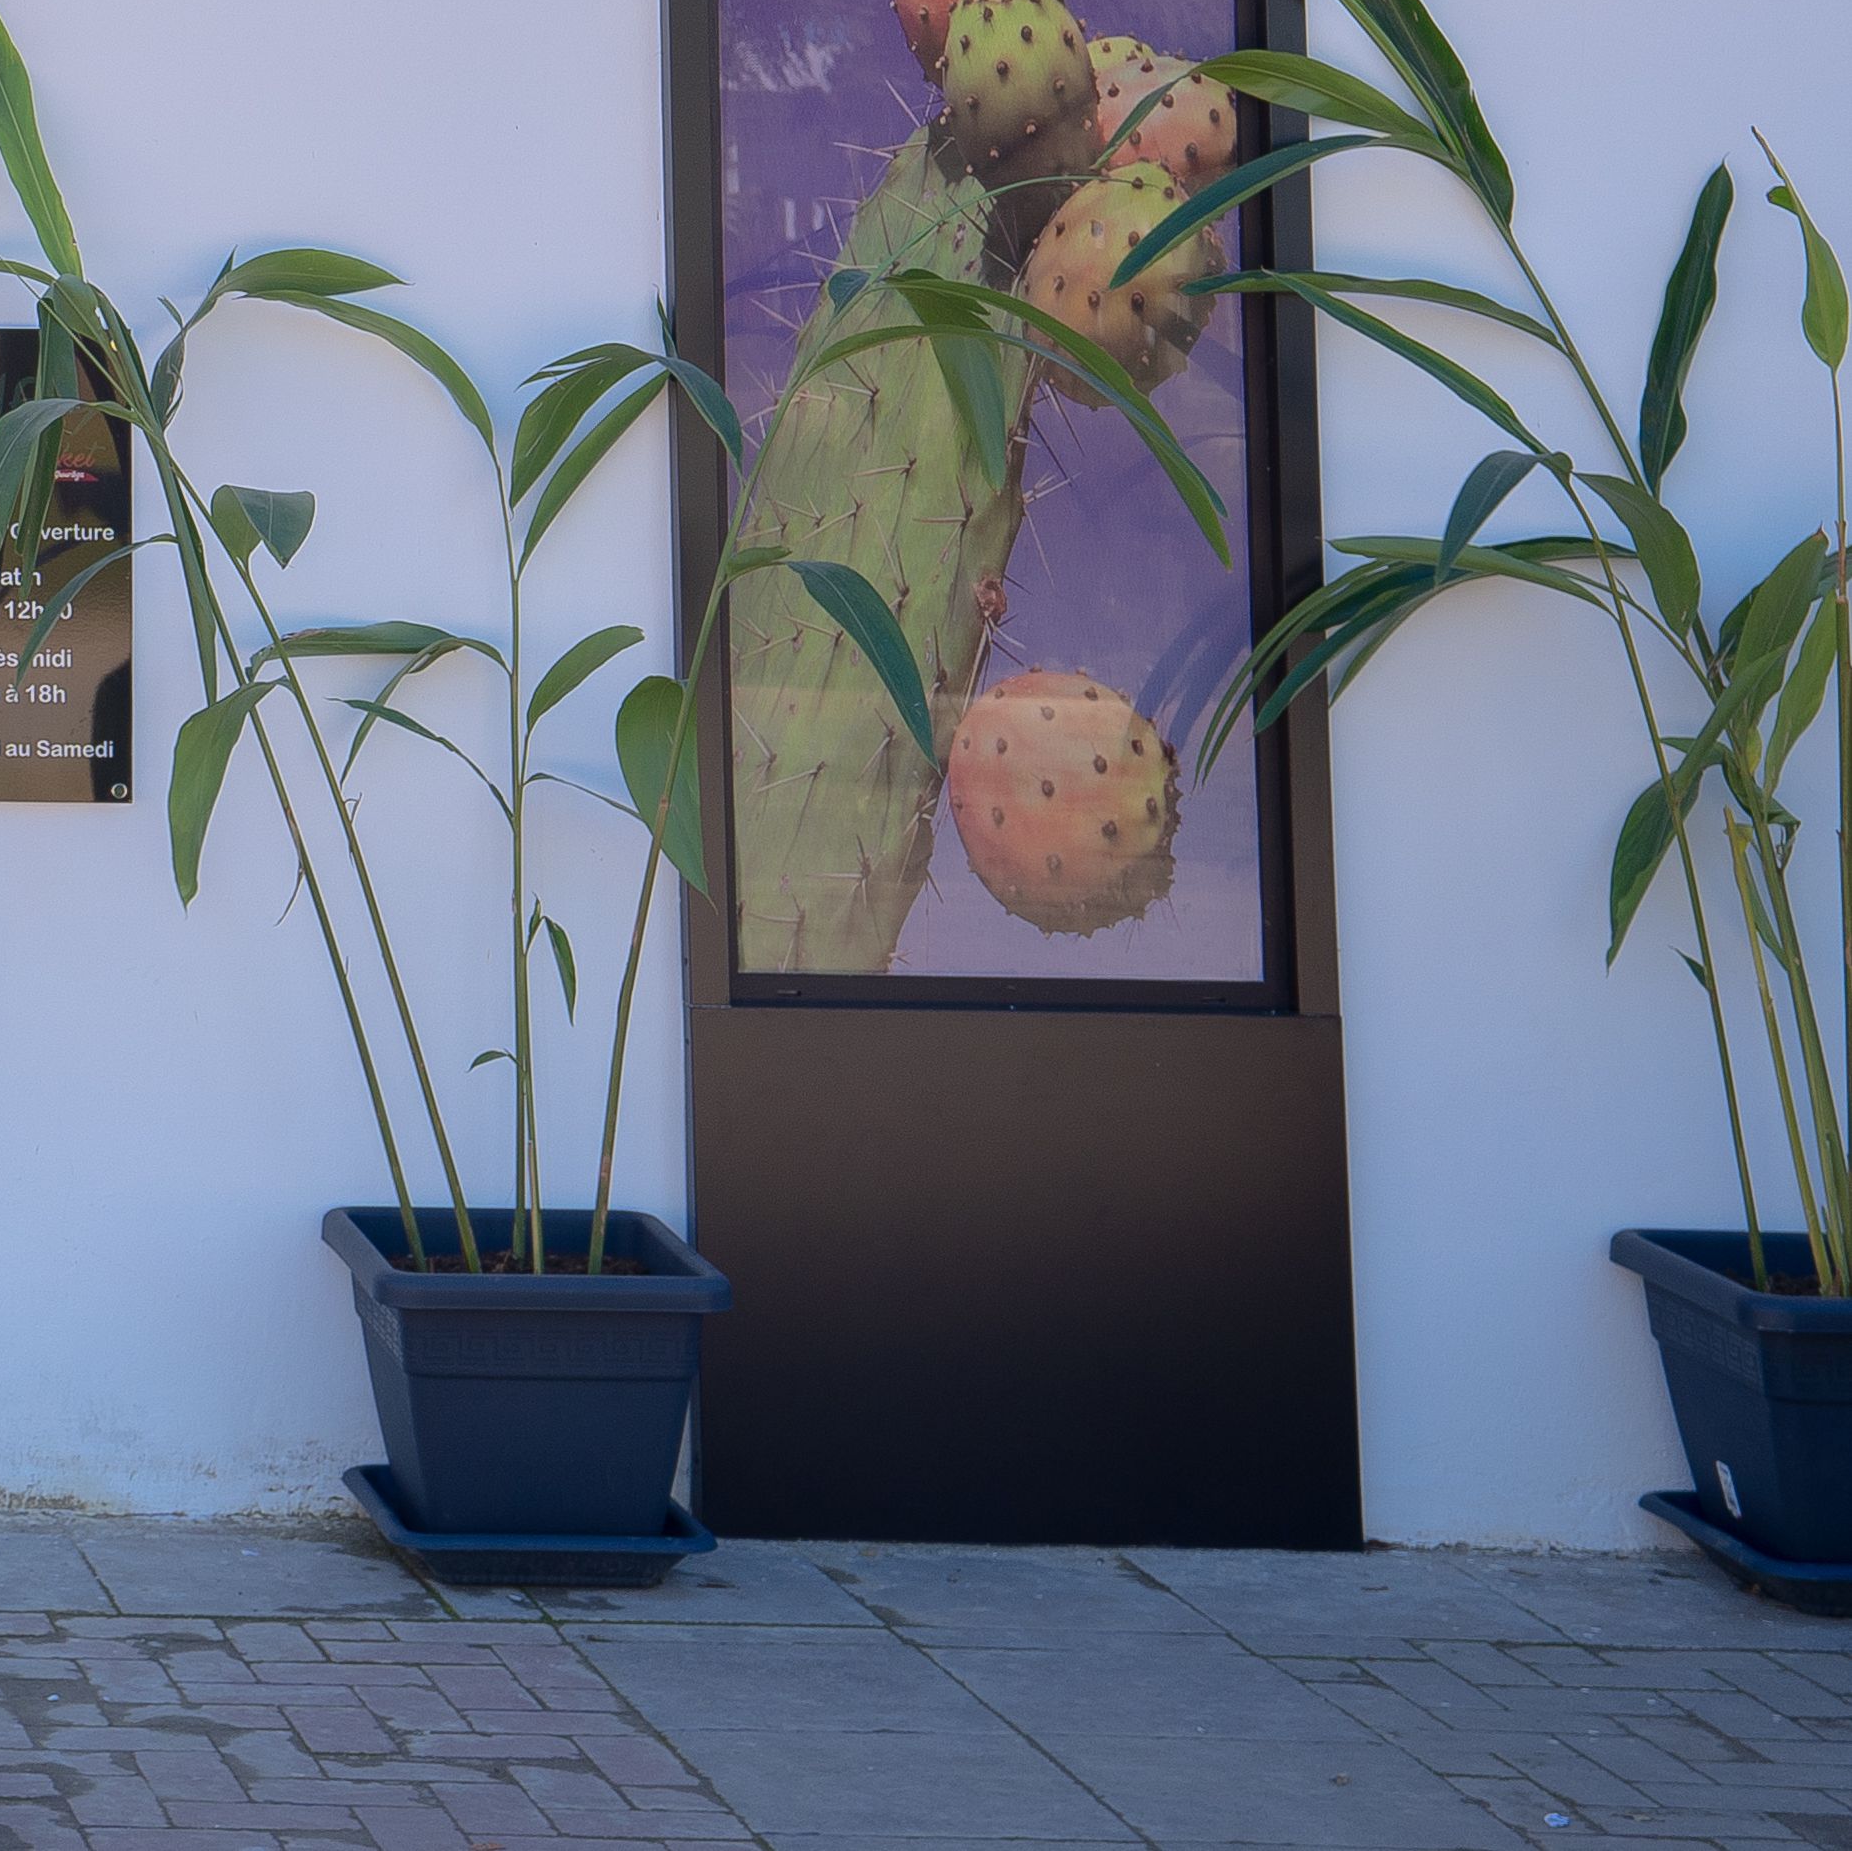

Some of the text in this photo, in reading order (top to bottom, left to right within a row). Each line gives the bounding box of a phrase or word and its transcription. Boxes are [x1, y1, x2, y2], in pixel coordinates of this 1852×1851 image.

[3, 600, 74, 620] 12h0
[4, 684, 19, 703] à
[25, 684, 66, 704] 18h
[5, 743, 31, 759] au
[35, 738, 115, 760] Samedi
